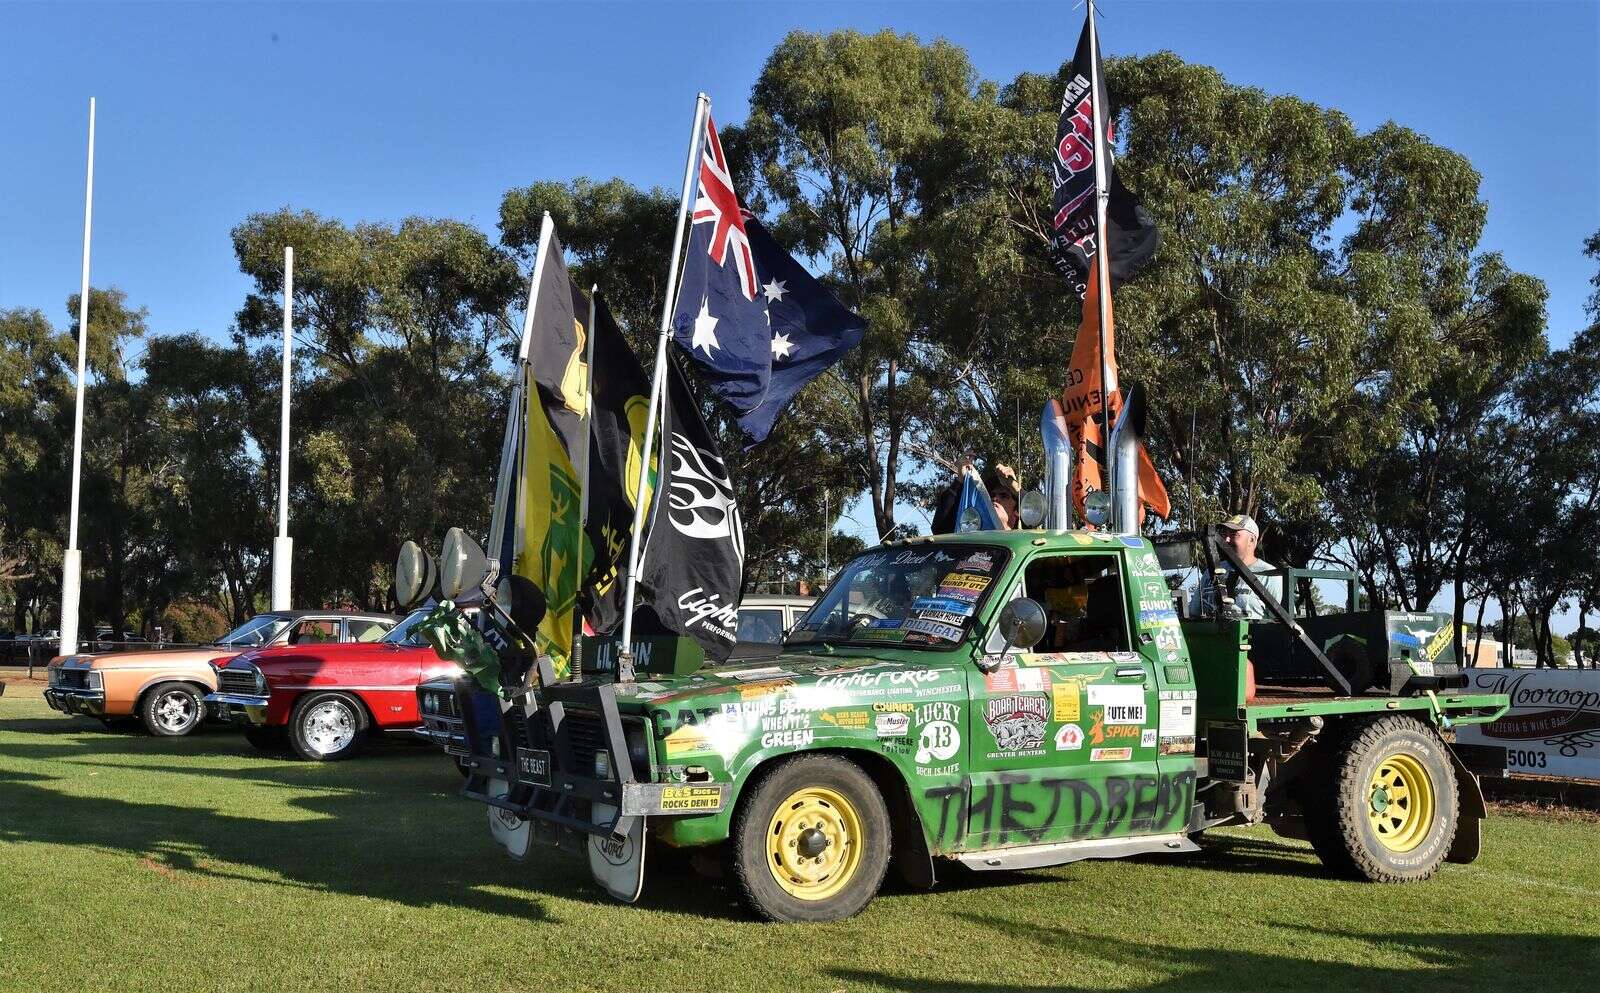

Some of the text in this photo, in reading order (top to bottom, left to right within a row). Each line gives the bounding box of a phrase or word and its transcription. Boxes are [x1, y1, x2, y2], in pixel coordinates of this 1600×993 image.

[678, 587, 738, 632] Light
[1140, 600, 1173, 611] BUNDY
[905, 619, 962, 639] DILLIGAF
[916, 684, 962, 697] WINCHESTER
[1476, 673, 1600, 722] Mooroop
[761, 716, 788, 732] WHEN
[914, 701, 962, 728] LUCKY
[761, 729, 814, 749] GREEN
[934, 725, 952, 748] 13
[1106, 725, 1140, 738] SPIKA
[1018, 749, 1047, 757] HUNTERS
[1507, 750, 1547, 768] 5003
[662, 798, 718, 809] ROCKS DENI 19
[925, 770, 1034, 848] THE
